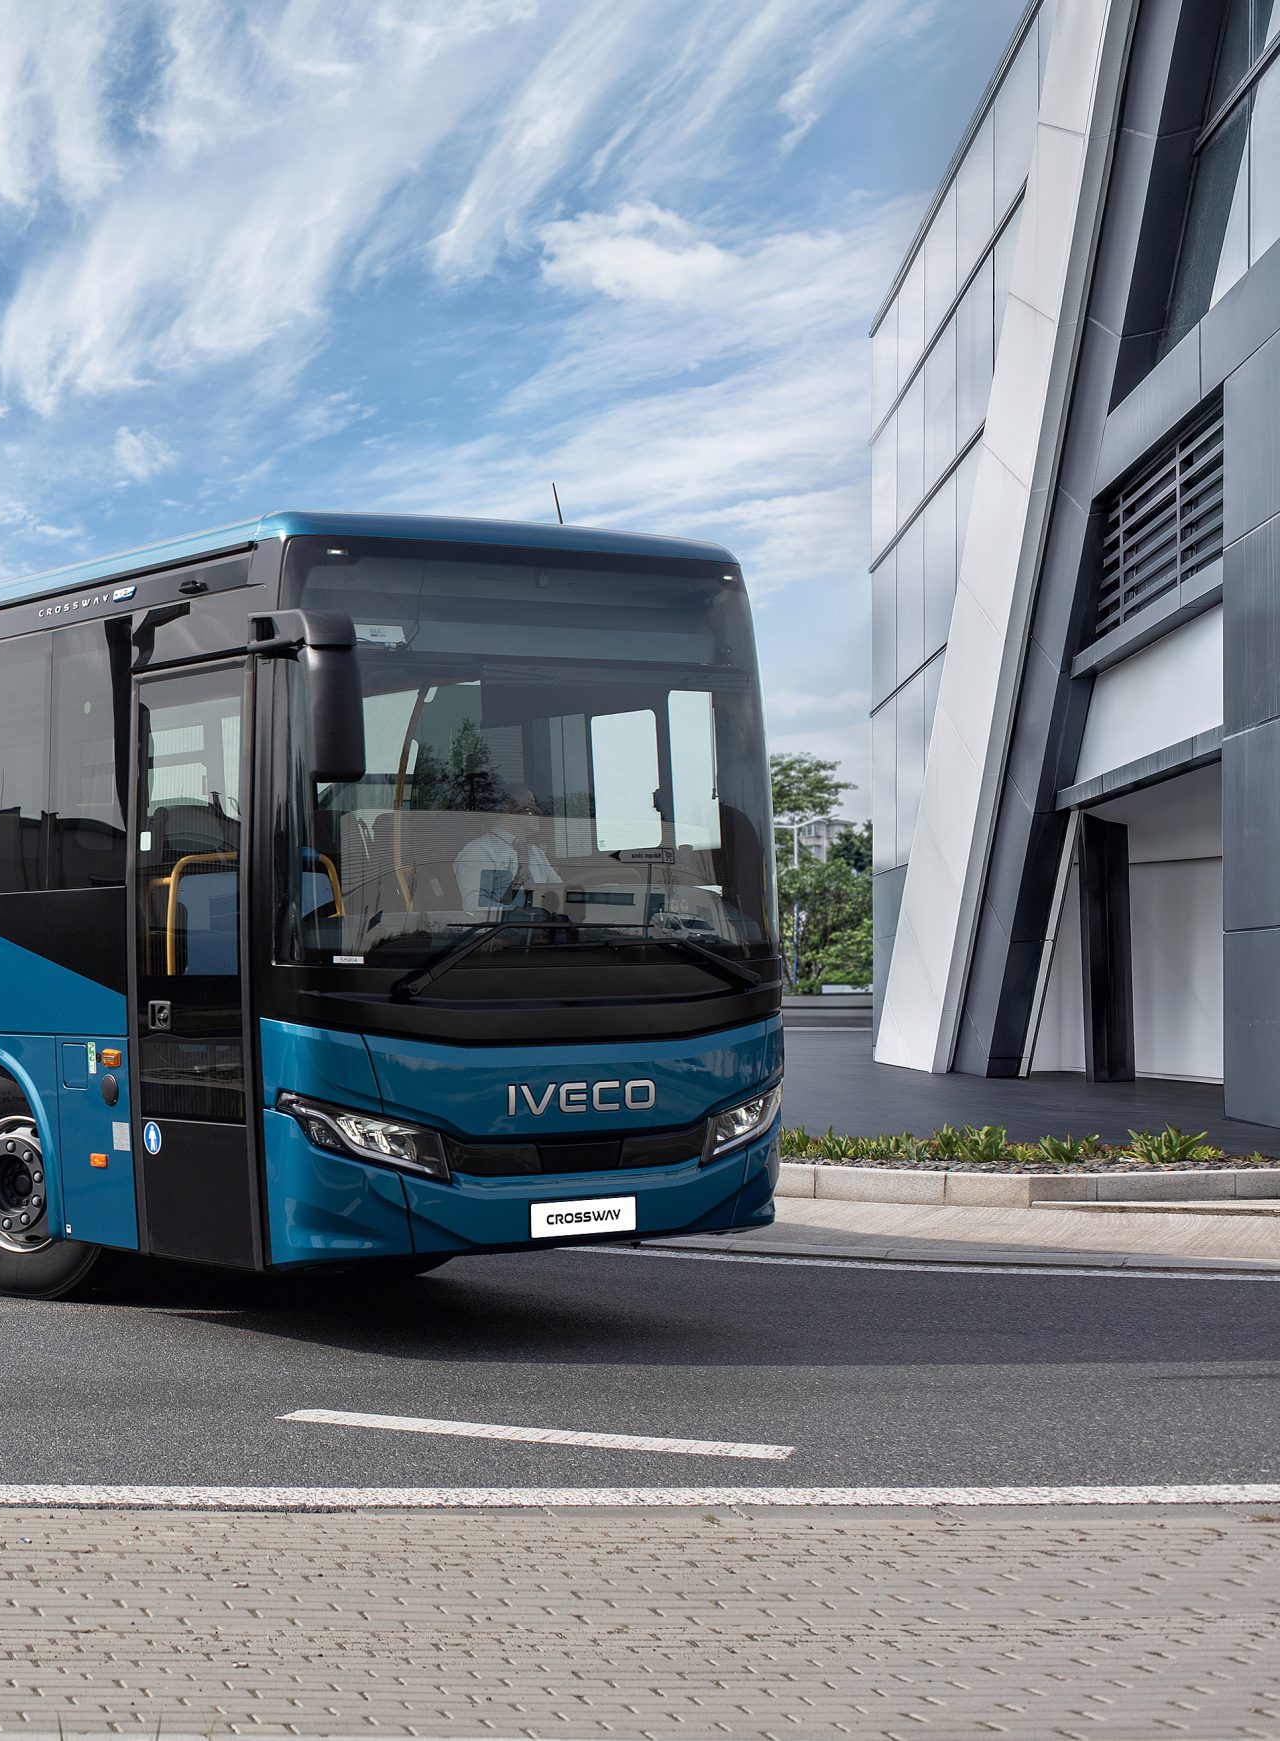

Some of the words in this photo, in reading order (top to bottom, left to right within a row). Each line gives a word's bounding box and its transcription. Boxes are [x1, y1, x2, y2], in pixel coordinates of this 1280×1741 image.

[38, 594, 109, 617] CROSSWAY
[507, 1079, 656, 1116] IVECO
[546, 1208, 621, 1225] CROSSWAY
